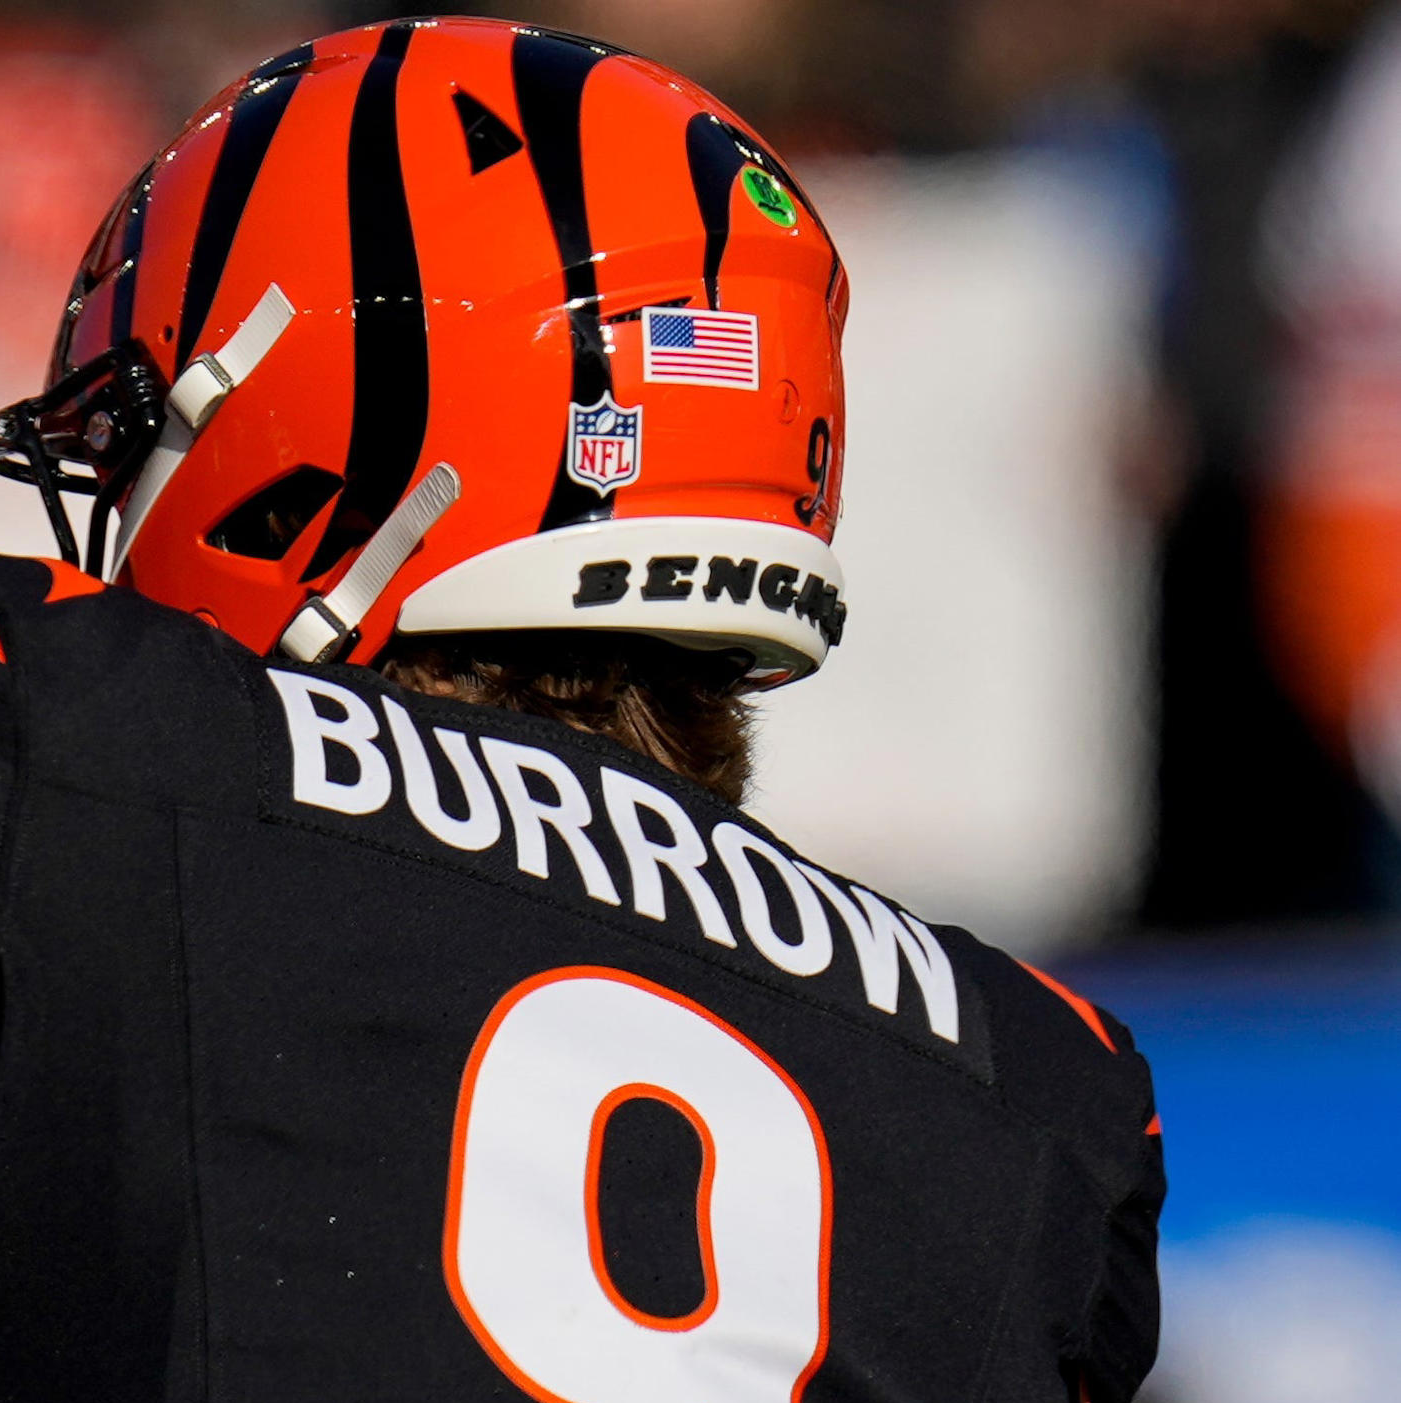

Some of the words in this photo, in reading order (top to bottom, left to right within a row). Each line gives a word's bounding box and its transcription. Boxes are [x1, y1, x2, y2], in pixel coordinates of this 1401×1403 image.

[578, 439, 630, 478] NFL
[572, 555, 847, 646] BENGA
[264, 666, 960, 1045] BURROW
